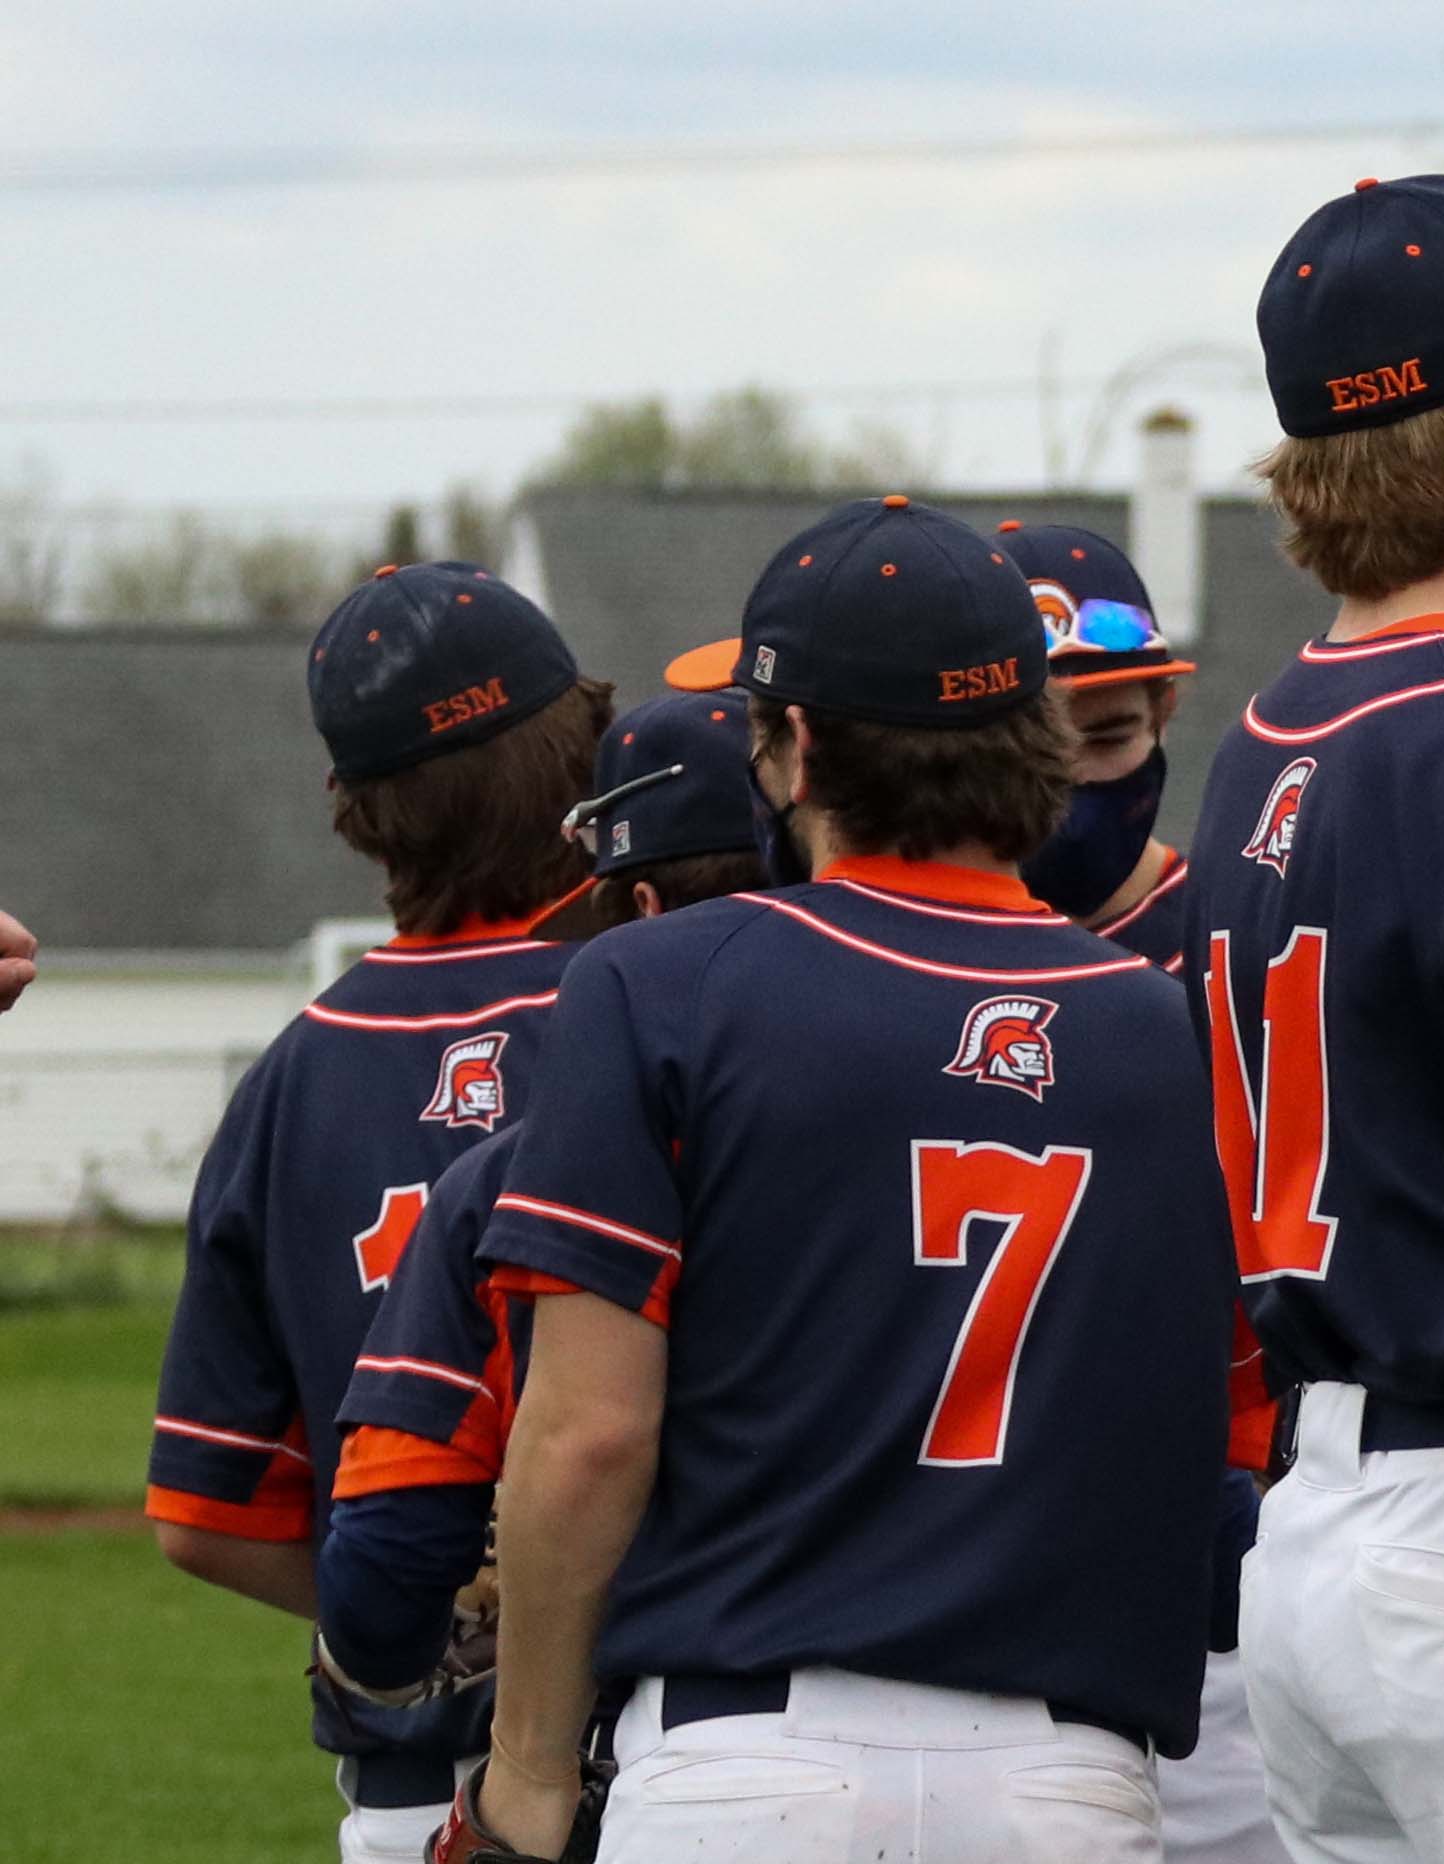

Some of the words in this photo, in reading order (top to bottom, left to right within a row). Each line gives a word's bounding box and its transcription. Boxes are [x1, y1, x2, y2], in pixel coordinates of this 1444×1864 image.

[1326, 357, 1430, 412] ESM
[423, 676, 509, 735] ESM
[938, 656, 1021, 703] ESM
[1203, 925, 1340, 1285] 11
[910, 1138, 1093, 1467] 7
